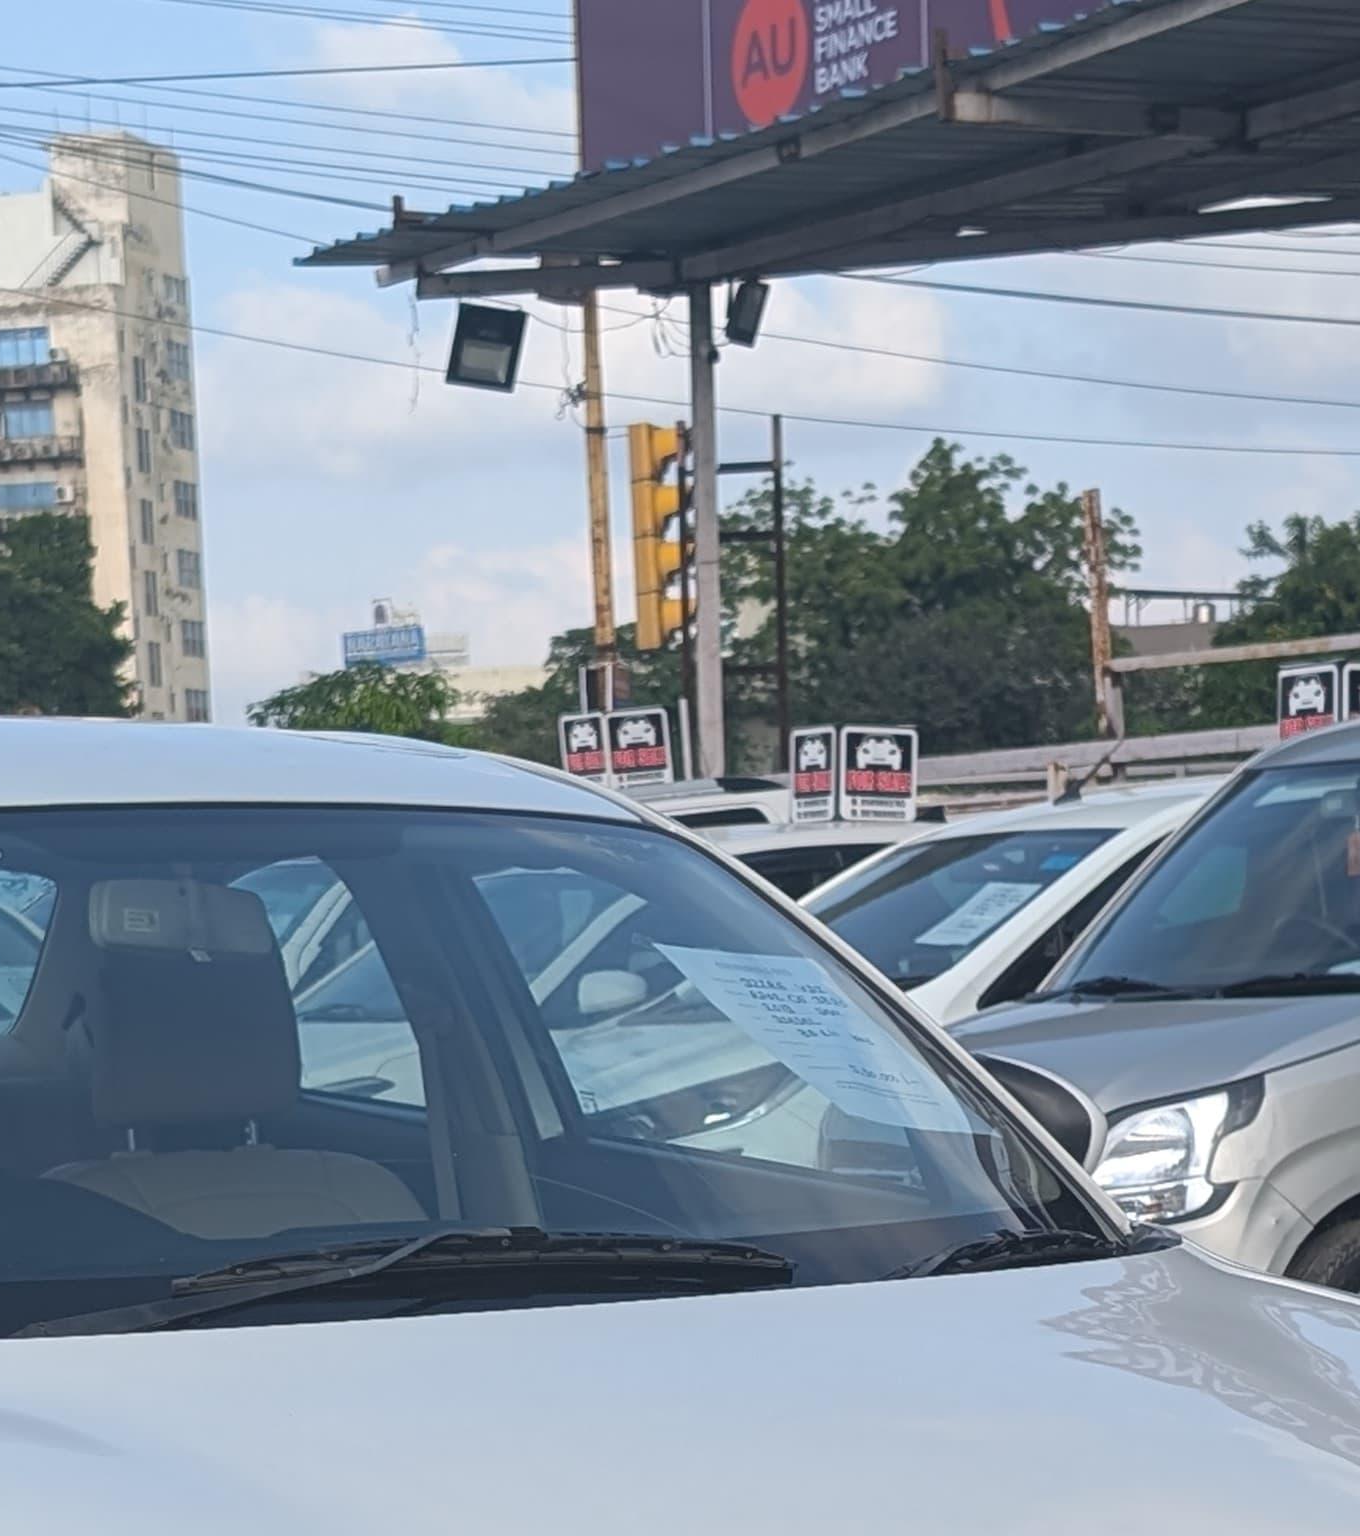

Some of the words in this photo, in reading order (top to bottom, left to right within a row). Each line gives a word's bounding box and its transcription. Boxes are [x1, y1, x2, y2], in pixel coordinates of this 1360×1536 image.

[814, 0, 877, 32] SMALL
[814, 9, 898, 63] FINANCE
[741, 17, 796, 89] AU
[814, 51, 869, 95] BANK
